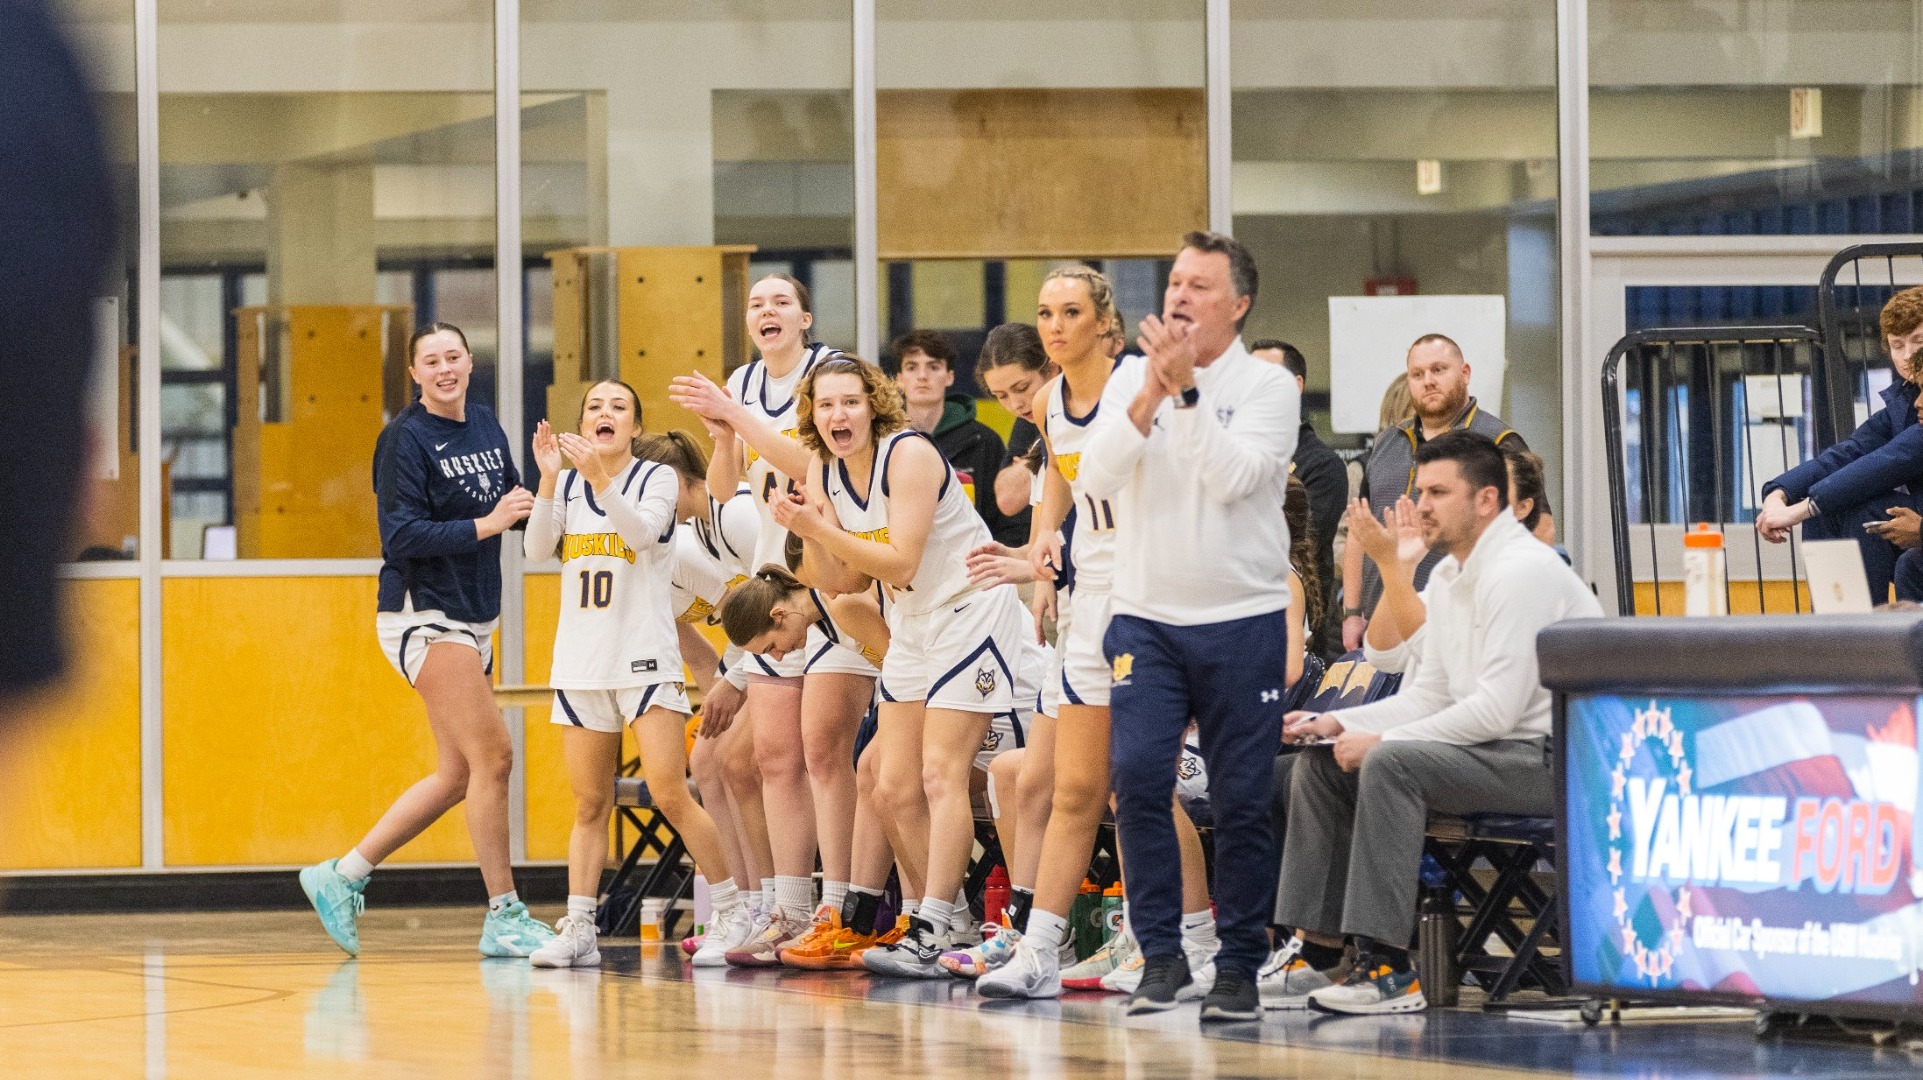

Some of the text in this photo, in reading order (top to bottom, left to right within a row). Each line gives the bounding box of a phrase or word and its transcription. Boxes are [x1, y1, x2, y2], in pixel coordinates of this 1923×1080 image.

[580, 570, 613, 608] 10
[1628, 778, 1901, 888] YANKEE FORD
